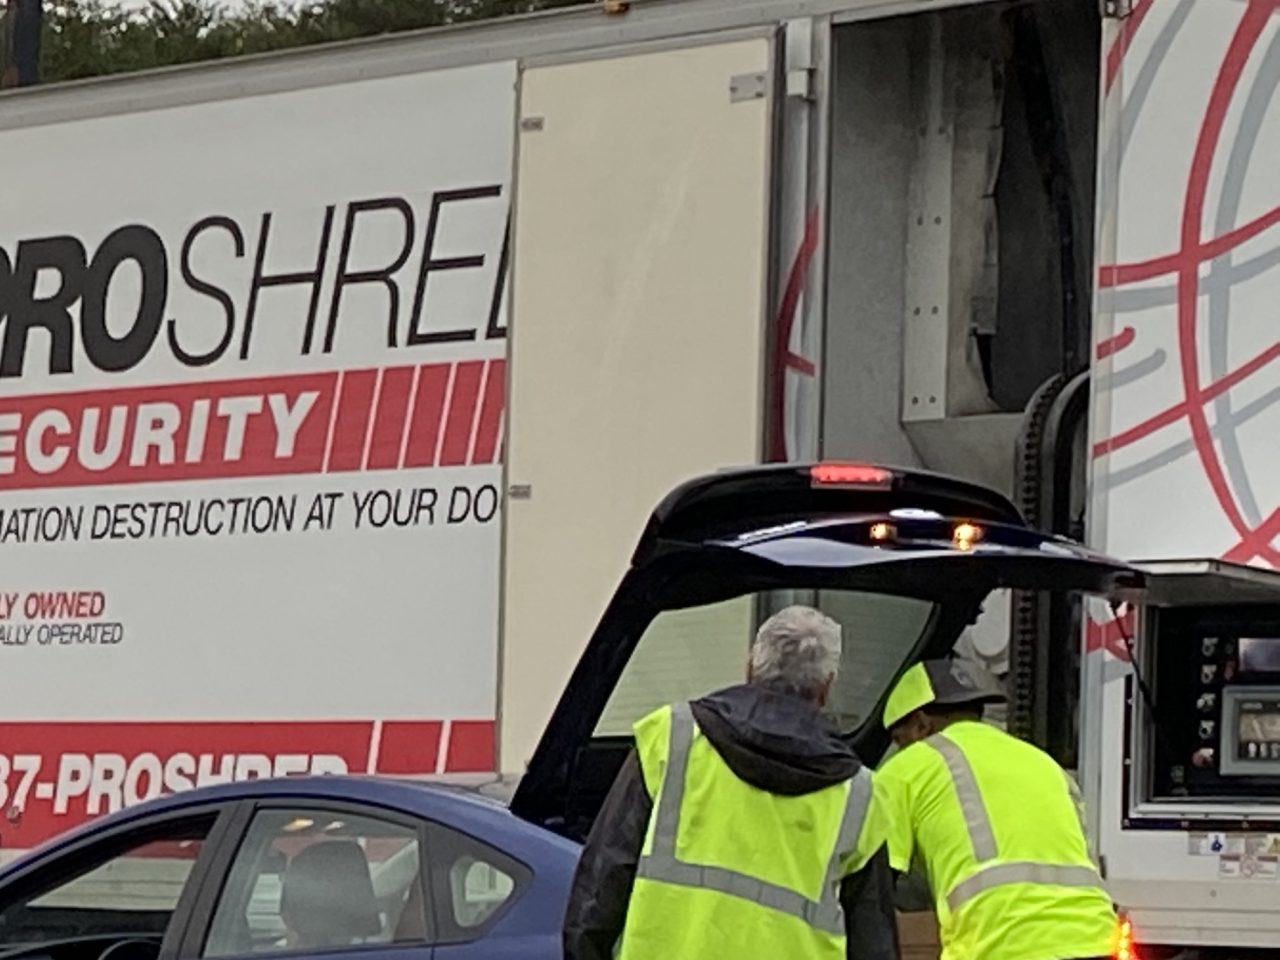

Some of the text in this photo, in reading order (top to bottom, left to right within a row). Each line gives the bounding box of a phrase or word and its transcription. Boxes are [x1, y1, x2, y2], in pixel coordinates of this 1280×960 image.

[90, 495, 297, 540] DESTRUCTION
[303, 492, 345, 531] AT
[352, 487, 439, 528] YOUR
[446, 484, 502, 524] DO
[23, 591, 106, 619] OWNED
[36, 622, 124, 646] OPERATED
